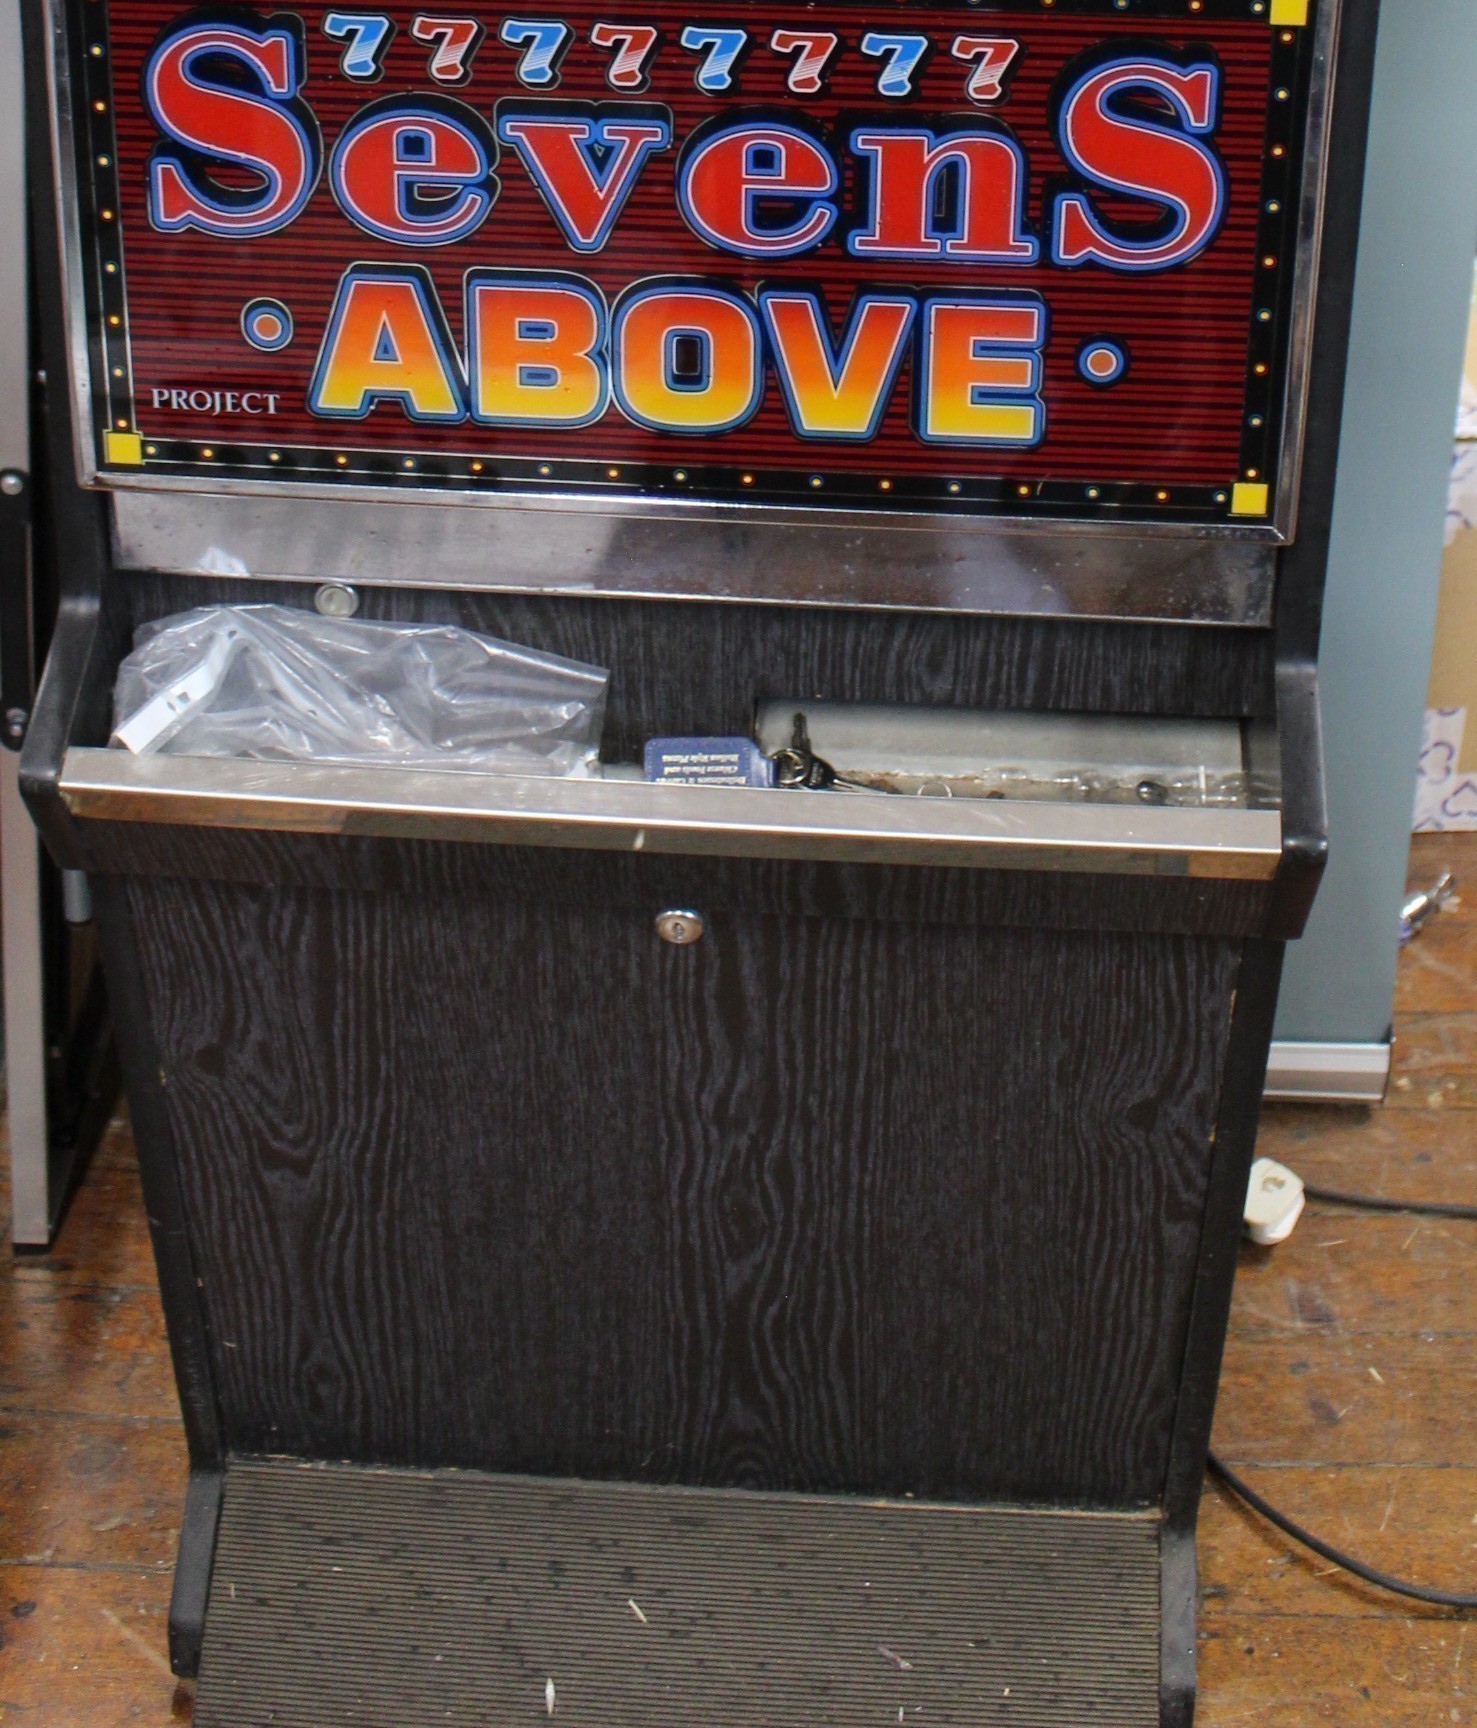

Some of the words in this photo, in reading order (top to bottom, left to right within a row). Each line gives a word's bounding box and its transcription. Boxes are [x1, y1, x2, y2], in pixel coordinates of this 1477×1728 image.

[144, 12, 1229, 270] SevenS
[150, 386, 281, 416] PROJECT
[309, 265, 1046, 447] ABOVE
